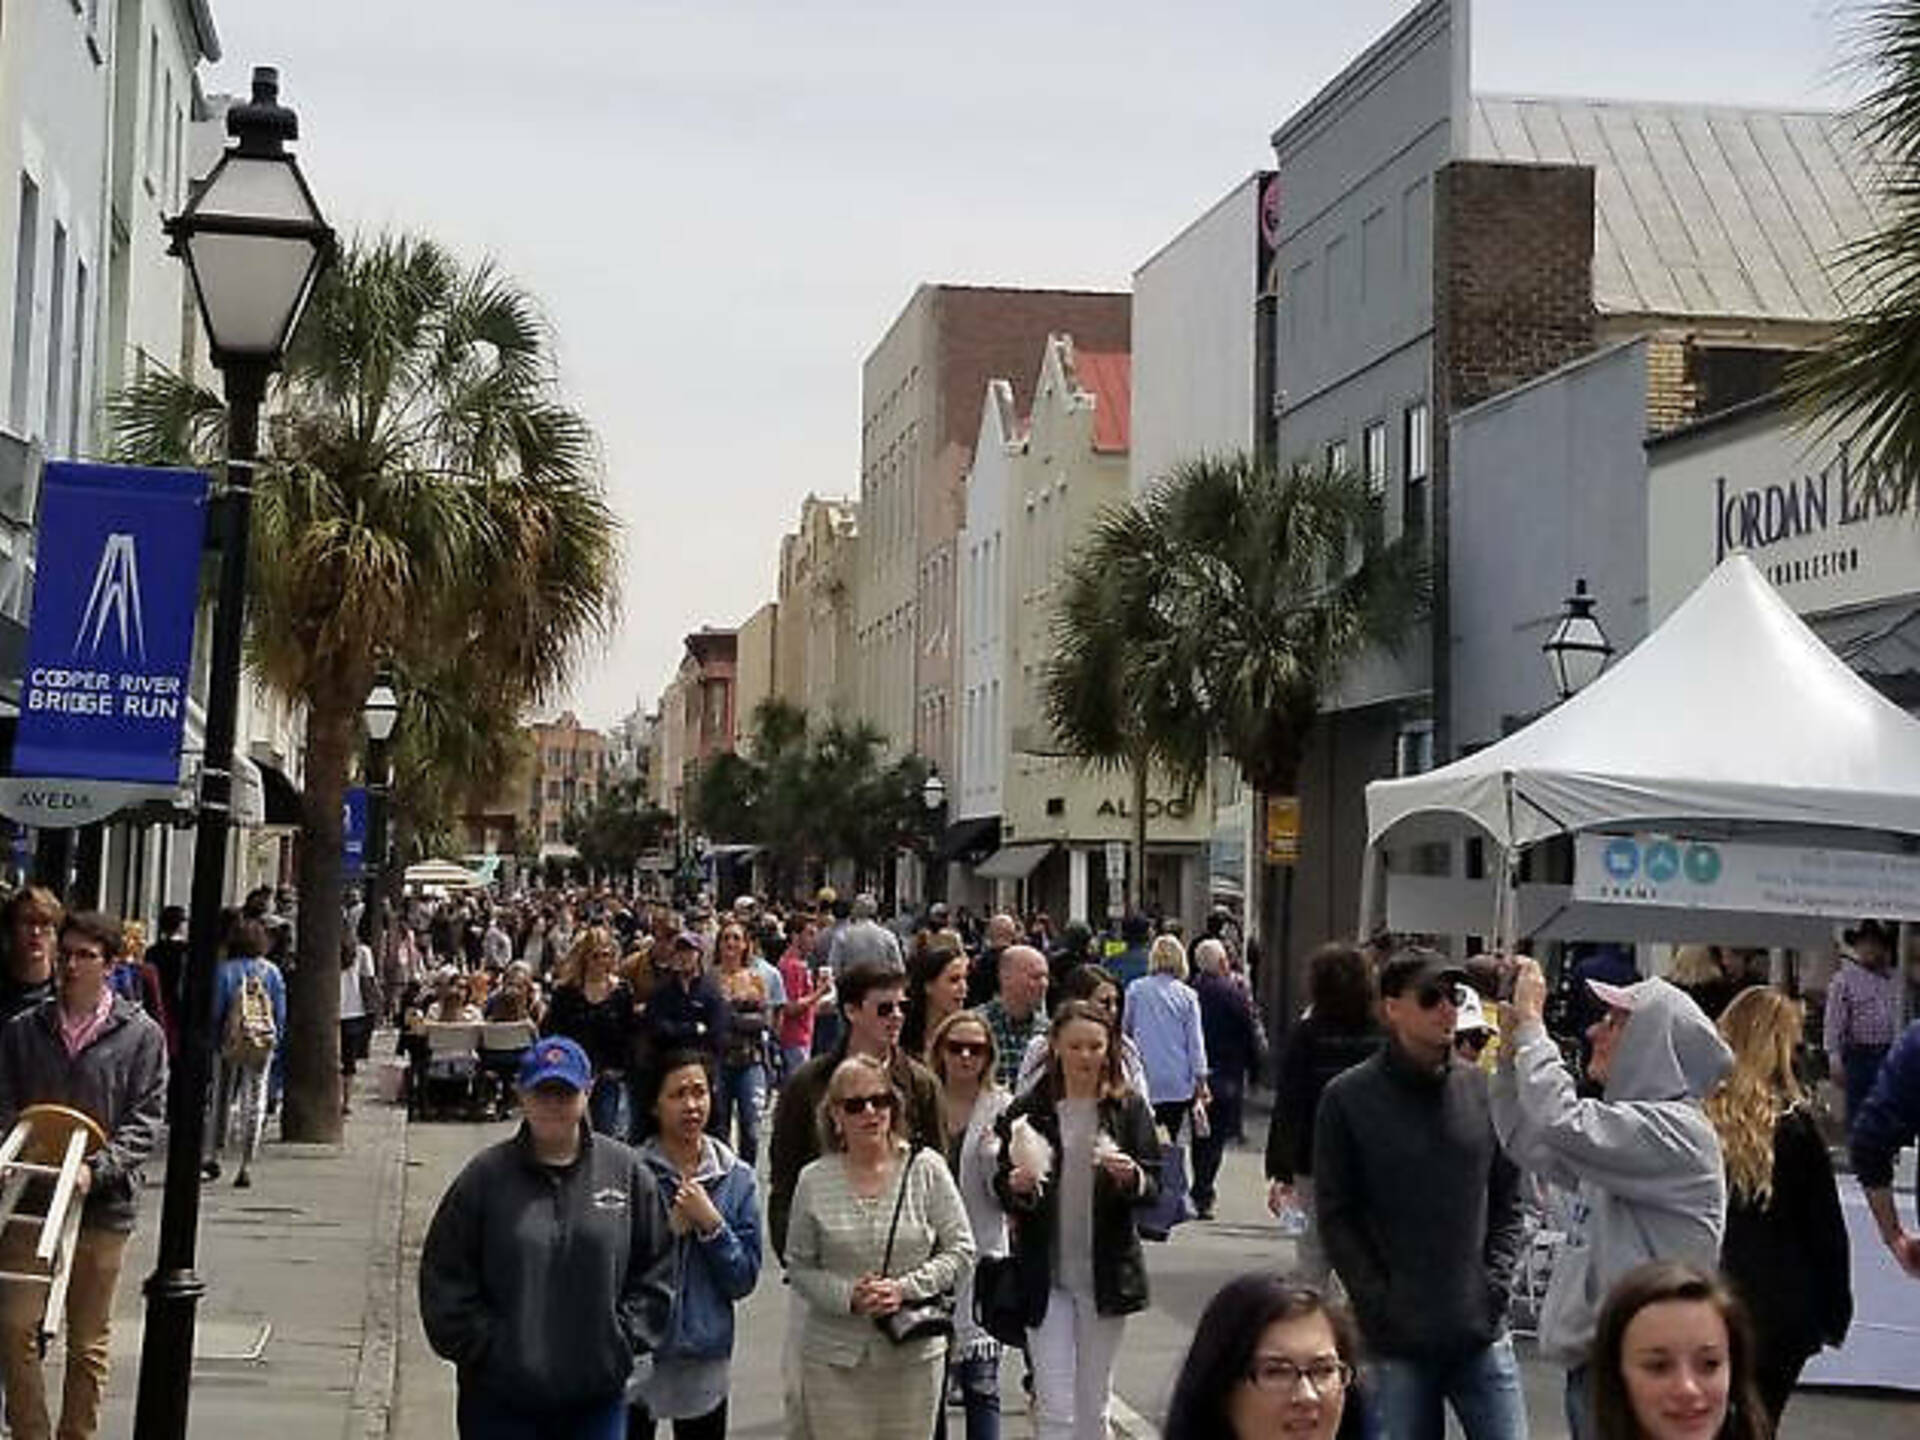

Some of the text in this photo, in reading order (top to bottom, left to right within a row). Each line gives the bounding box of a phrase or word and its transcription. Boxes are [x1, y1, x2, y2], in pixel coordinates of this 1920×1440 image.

[1716, 471, 1828, 566] JORDAN
[1767, 548, 1858, 586] CHARLESTON
[32, 668, 180, 696] COOPER RIVER
[28, 689, 179, 719] BRIDGE RUN
[17, 791, 92, 809] AVEDA
